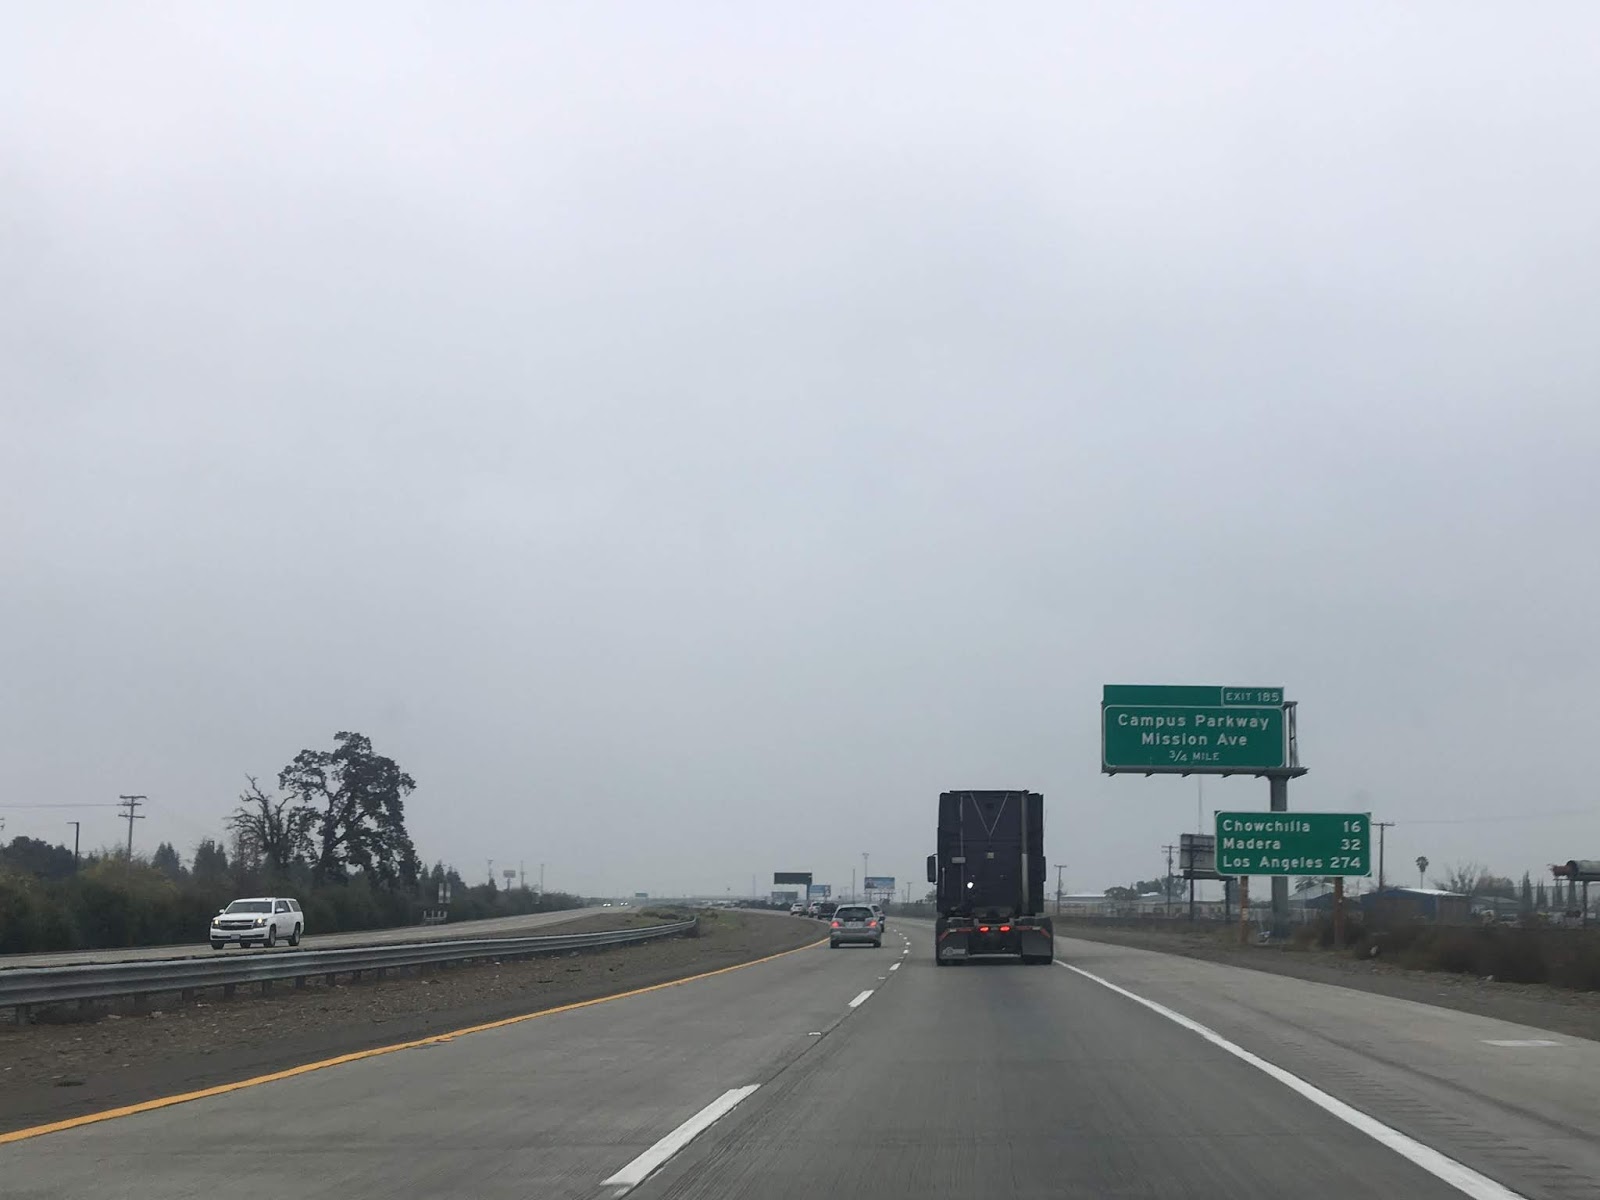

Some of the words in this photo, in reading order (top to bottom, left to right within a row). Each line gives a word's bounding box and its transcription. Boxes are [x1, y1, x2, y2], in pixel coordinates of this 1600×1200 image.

[1226, 692, 1252, 701] EXIT
[1258, 692, 1279, 702] 185
[1118, 714, 1186, 728] Campus
[1196, 715, 1268, 730] Parkway
[1142, 733, 1207, 745] Mission
[1217, 734, 1247, 745] Ave
[1193, 752, 1219, 761] MILE
[1223, 820, 1310, 832] Chowchilla
[1344, 821, 1361, 832] 16
[1224, 838, 1280, 849] Madera
[1342, 839, 1360, 850] 32
[1224, 856, 1250, 867] Los
[1260, 856, 1322, 871] Angeles
[1331, 857, 1360, 868] 274
